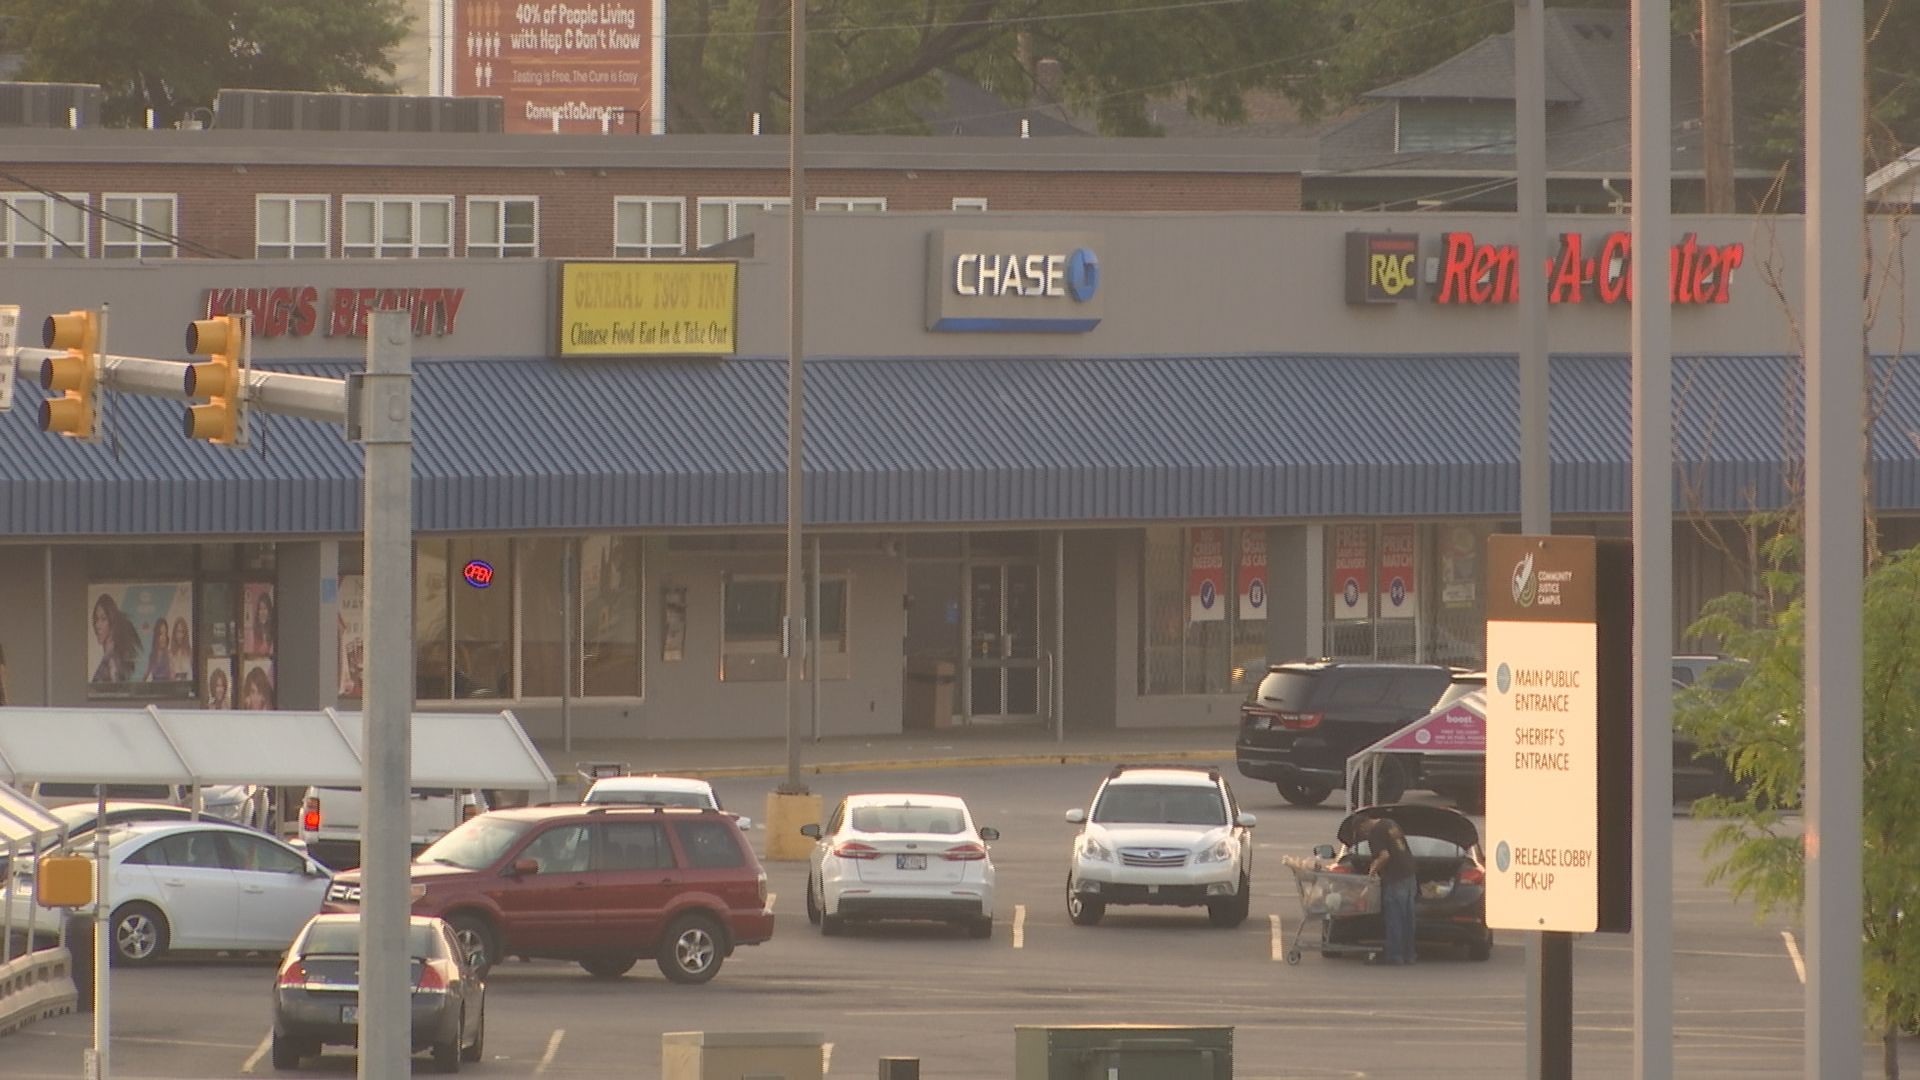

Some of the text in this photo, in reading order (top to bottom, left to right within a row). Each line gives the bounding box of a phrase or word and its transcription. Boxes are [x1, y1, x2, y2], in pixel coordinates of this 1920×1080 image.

[515, 2, 635, 29] 40% of People Living
[511, 28, 640, 54] with Hep C Don't Know
[513, 70, 543, 86] Testing
[573, 70, 588, 82] The
[589, 70, 609, 82] Cure
[618, 70, 638, 86] Easy
[956, 253, 1067, 296] CHASE
[1370, 253, 1416, 296] RAC
[575, 270, 644, 310] GENERAL
[697, 270, 729, 310] INN
[571, 320, 728, 346] Chinese Food Eat In & Take Out
[1336, 527, 1367, 547] FREE
[1382, 535, 1413, 552] PRICE
[1192, 555, 1223, 569] NEEDED
[1382, 553, 1413, 568] MATCH
[464, 563, 493, 583] OPEN
[1537, 571, 1573, 582] COMMUNITY
[1537, 582, 1560, 593] JUSTICE
[1537, 594, 1561, 605] CAMPUS
[1515, 669, 1580, 688] MAIN PUBLIC
[1514, 693, 1570, 712] ENTRANCE
[1514, 727, 1565, 746] SHERIFF'S
[1514, 752, 1570, 771] ENTRANCE
[1514, 847, 1592, 868] RELEASE LOBBY
[1514, 871, 1555, 891] PICK-UP
